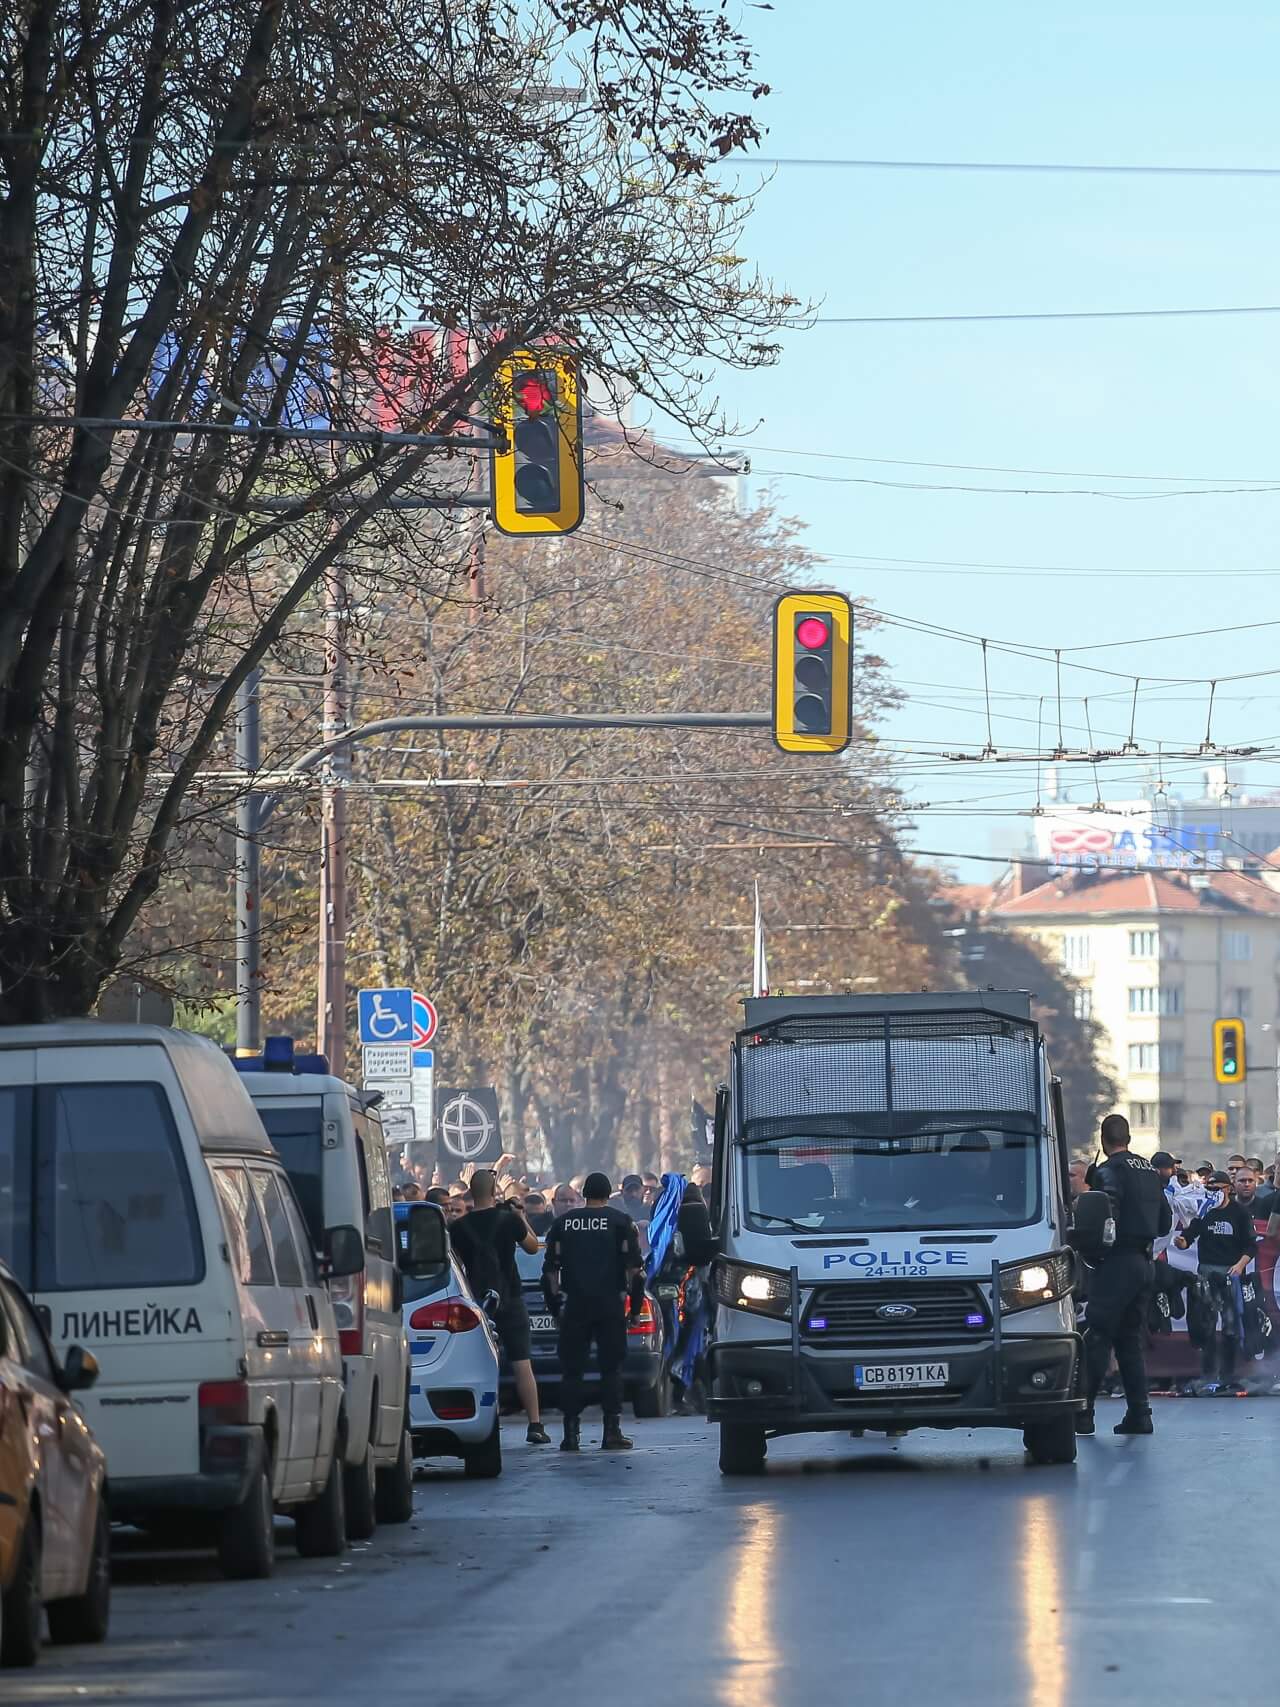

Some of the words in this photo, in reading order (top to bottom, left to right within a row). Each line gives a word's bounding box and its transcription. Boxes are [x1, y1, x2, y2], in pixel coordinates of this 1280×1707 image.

[1126, 1158, 1155, 1171] POLIC
[564, 1218, 608, 1231] POLICE
[823, 1250, 969, 1269] POLICE
[865, 1265, 928, 1277] 24-1128
[61, 1302, 203, 1340] ЛИНЕЙКА
